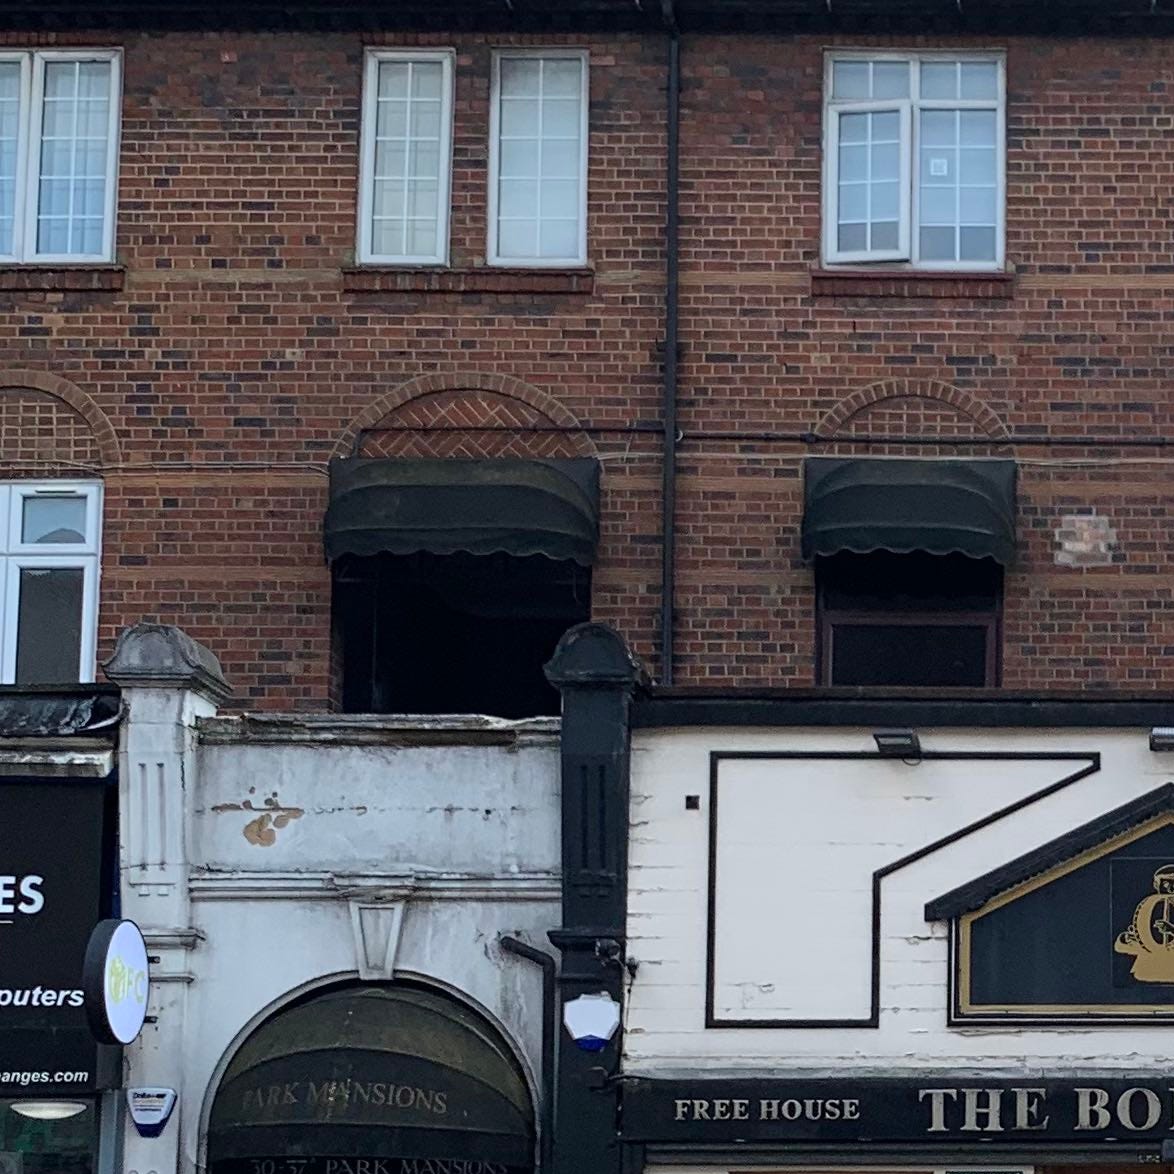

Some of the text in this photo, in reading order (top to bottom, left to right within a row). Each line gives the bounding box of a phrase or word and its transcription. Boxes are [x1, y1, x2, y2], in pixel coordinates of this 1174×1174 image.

[0, 1071, 89, 1086] anges.com
[309, 1079, 448, 1114] MANSIONS
[674, 1099, 861, 1121] FREE HOUSE
[919, 1087, 1050, 1133] THE
